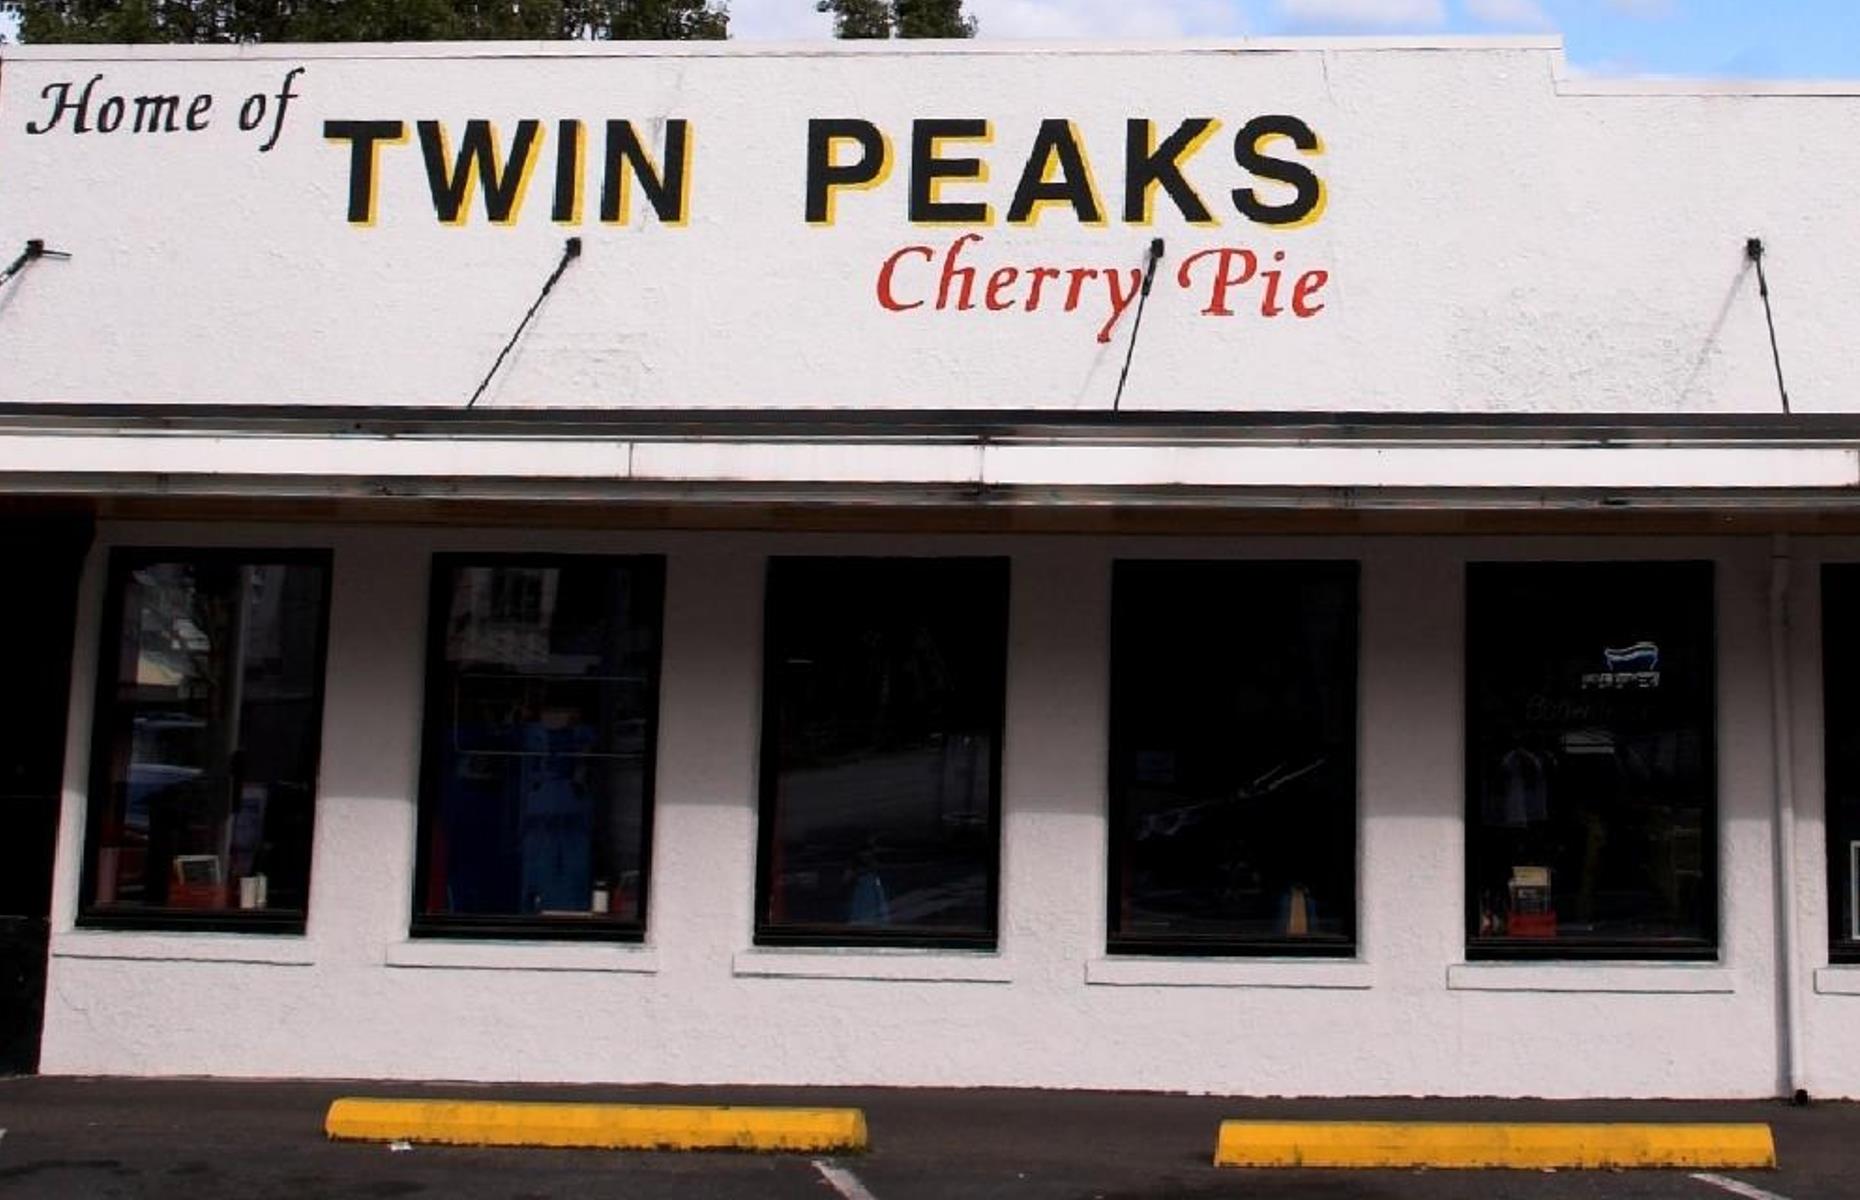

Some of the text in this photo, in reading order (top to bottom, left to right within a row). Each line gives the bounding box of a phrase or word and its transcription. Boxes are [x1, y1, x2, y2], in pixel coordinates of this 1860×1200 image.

[26, 67, 305, 152] Home of
[323, 114, 1328, 228] TWIN PEAKS
[875, 234, 1329, 343] Cherry Pie
